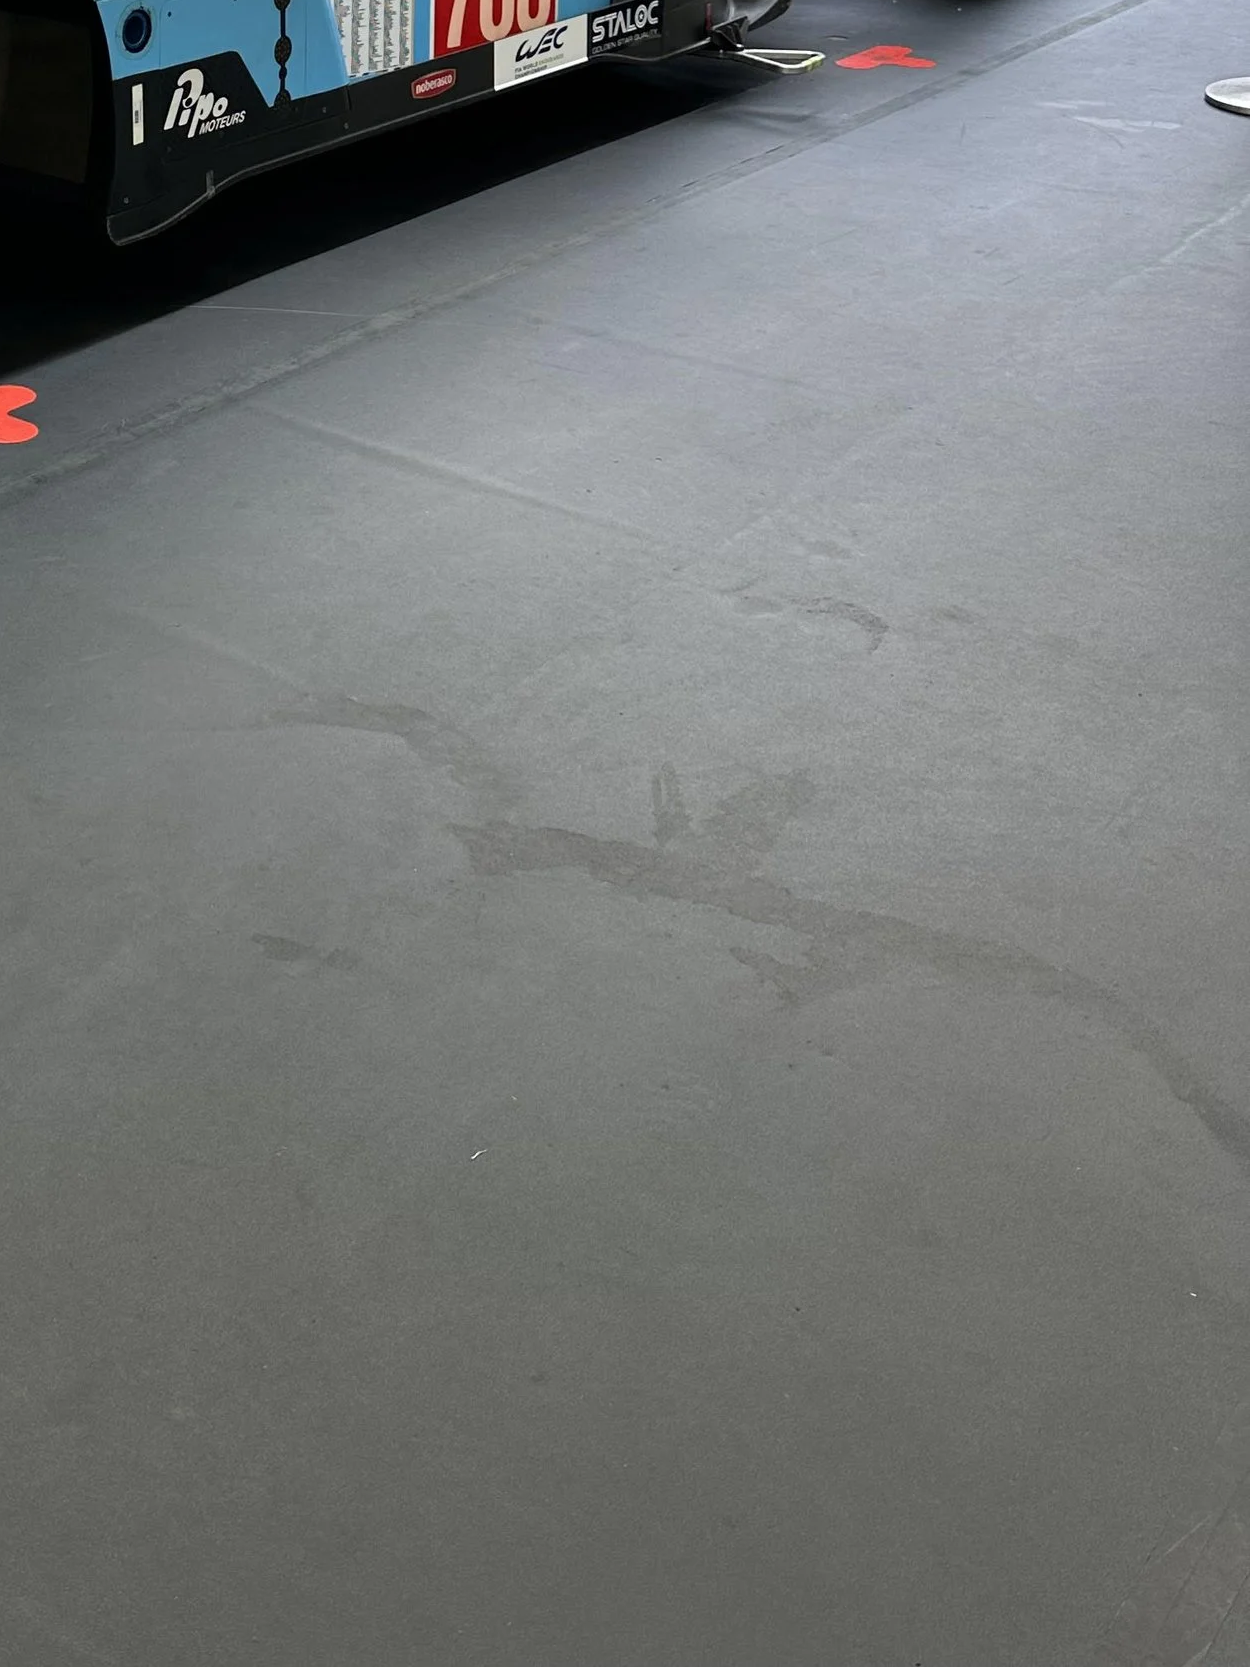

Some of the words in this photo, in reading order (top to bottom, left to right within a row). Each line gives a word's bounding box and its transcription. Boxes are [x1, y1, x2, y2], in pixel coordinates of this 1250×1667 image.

[592, 0, 660, 43] STALOC
[515, 25, 568, 62] WEC
[415, 73, 453, 94] noberasco
[199, 111, 246, 135] MOTEURS
